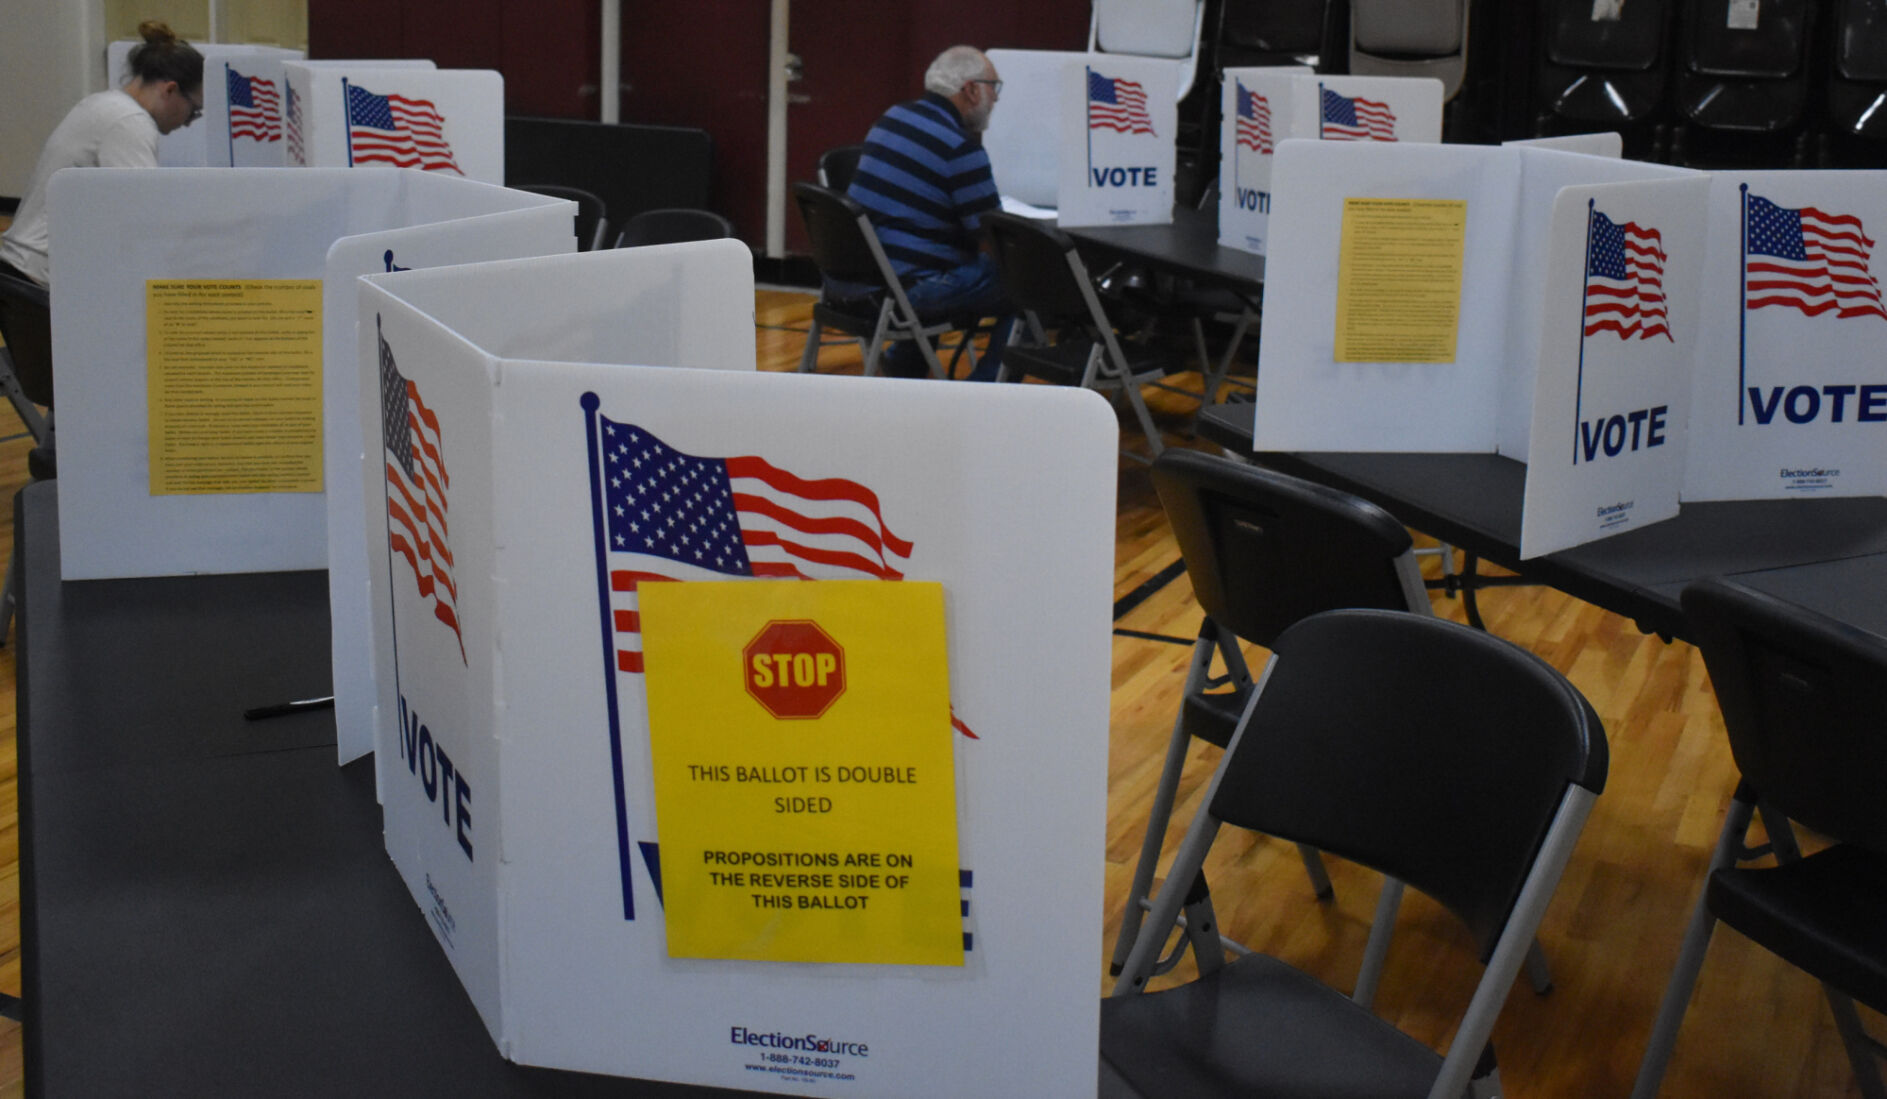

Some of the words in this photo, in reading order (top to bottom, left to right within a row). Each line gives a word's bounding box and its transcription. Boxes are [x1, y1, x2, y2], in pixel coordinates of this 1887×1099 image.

[1093, 167, 1157, 187] VOTE
[1748, 384, 1887, 425] VOTE
[1580, 405, 1668, 462] VOTE
[752, 653, 836, 688] STOP
[401, 694, 474, 863] VOTE
[688, 764, 731, 783] THIS
[736, 765, 808, 784] BALLOT
[815, 766, 832, 784] IS
[838, 766, 918, 784] DOUBLE
[774, 796, 833, 814] SIDED
[703, 850, 840, 868] PROPOSITIONS
[844, 852, 880, 868] ARE
[886, 853, 914, 869] ON
[709, 871, 746, 888] THE
[749, 872, 834, 889] REVERSE
[838, 874, 881, 889] SIDE
[885, 874, 910, 890] OF
[751, 894, 793, 910] THIS
[798, 895, 869, 911] BALLOT
[731, 1026, 868, 1057] ElectionSource
[760, 1052, 840, 1069] 1-888-742-8037
[744, 1062, 856, 1081] www.electionsource.com
